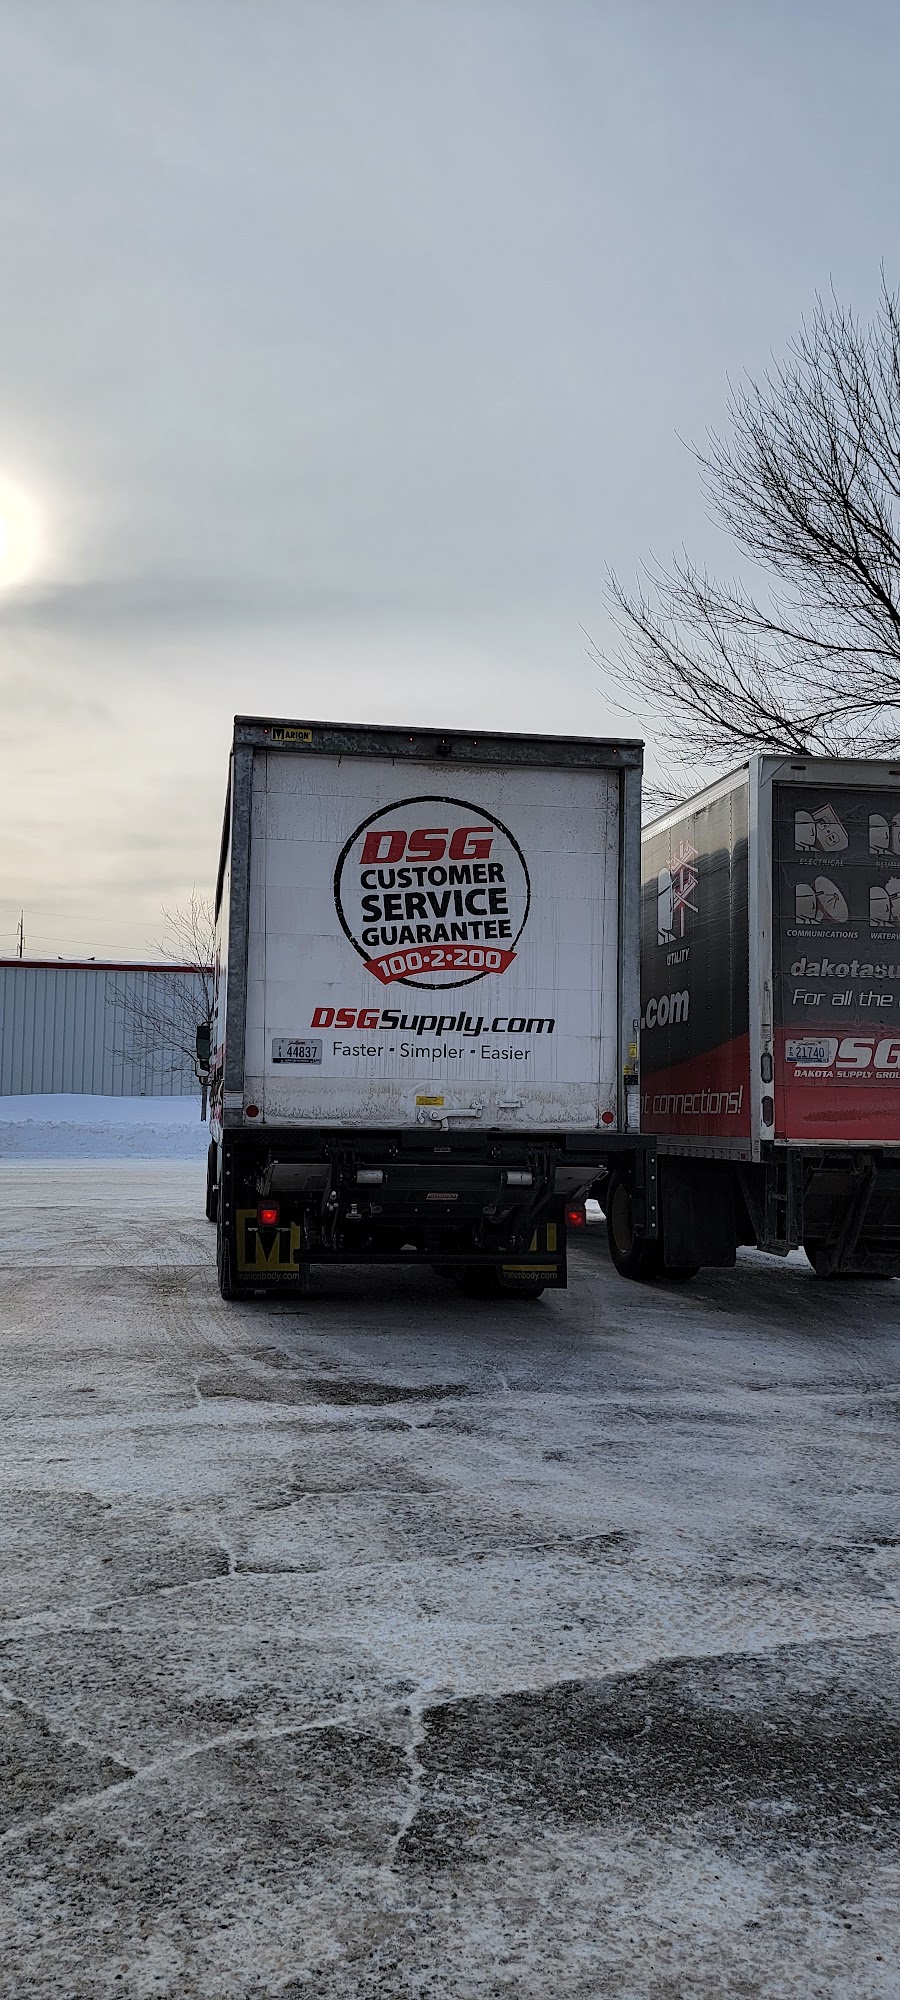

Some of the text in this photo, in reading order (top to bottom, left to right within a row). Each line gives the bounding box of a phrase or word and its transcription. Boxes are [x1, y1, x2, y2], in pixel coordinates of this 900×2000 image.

[272, 729, 309, 740] MARION
[359, 826, 494, 865] DSG
[799, 858, 844, 867] ELECTRICAL
[360, 863, 505, 890] CUSTOMER
[361, 887, 508, 922] SERVICE
[361, 919, 512, 947] GUARANTEE
[786, 929, 859, 939] COMMUNICATIONS
[666, 949, 689, 966] UTILITY
[792, 989, 894, 1007] For all the
[310, 1007, 555, 1037] DSGSupply.com
[286, 1046, 318, 1058] 44837
[332, 1041, 531, 1062] Faster Simpler Easier
[796, 1047, 825, 1058] 21740
[793, 1069, 834, 1078] DAKOTA
[836, 1070, 874, 1079] SUPPLY
[652, 1084, 744, 1115] connections!
